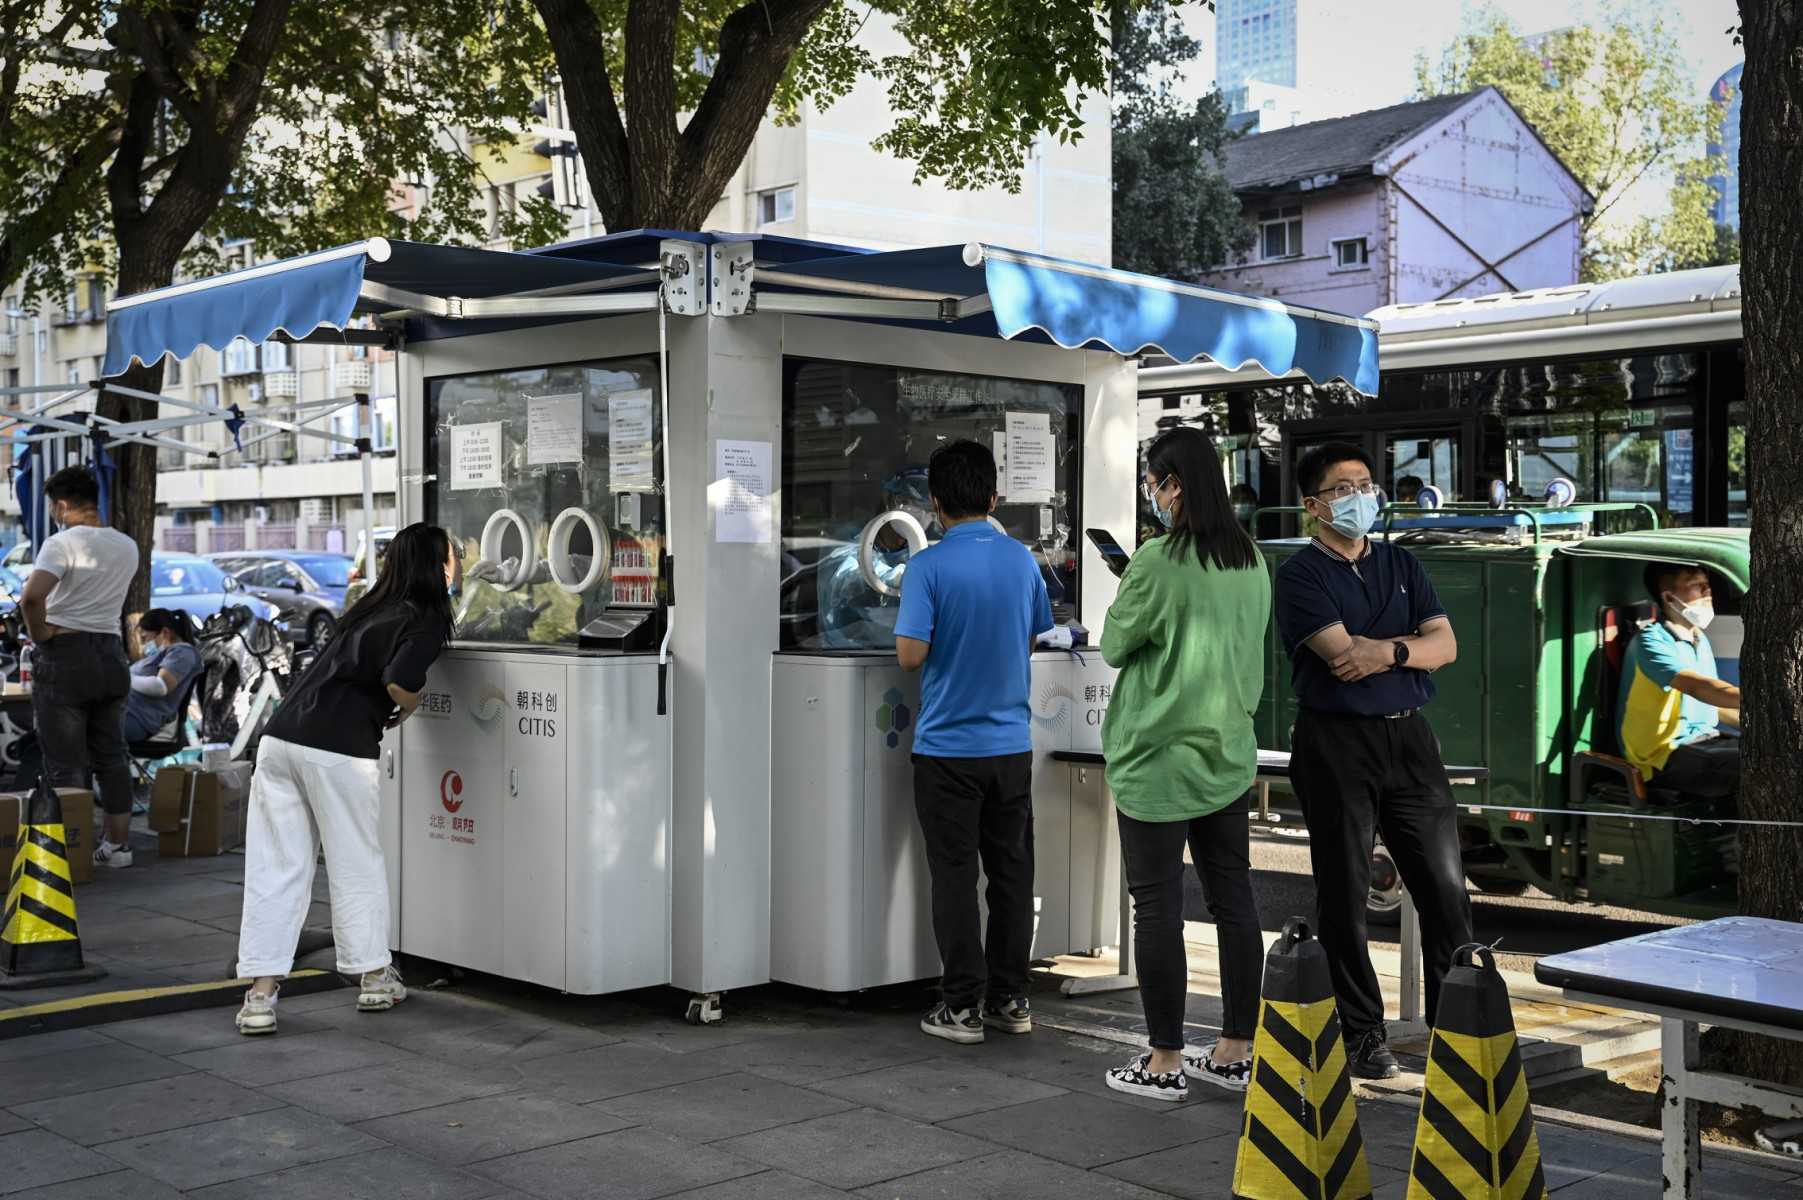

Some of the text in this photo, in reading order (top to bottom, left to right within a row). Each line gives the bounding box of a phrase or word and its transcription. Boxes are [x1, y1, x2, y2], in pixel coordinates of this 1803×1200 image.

[516, 690, 558, 713] 朝科创
[518, 716, 556, 738] CITIS
